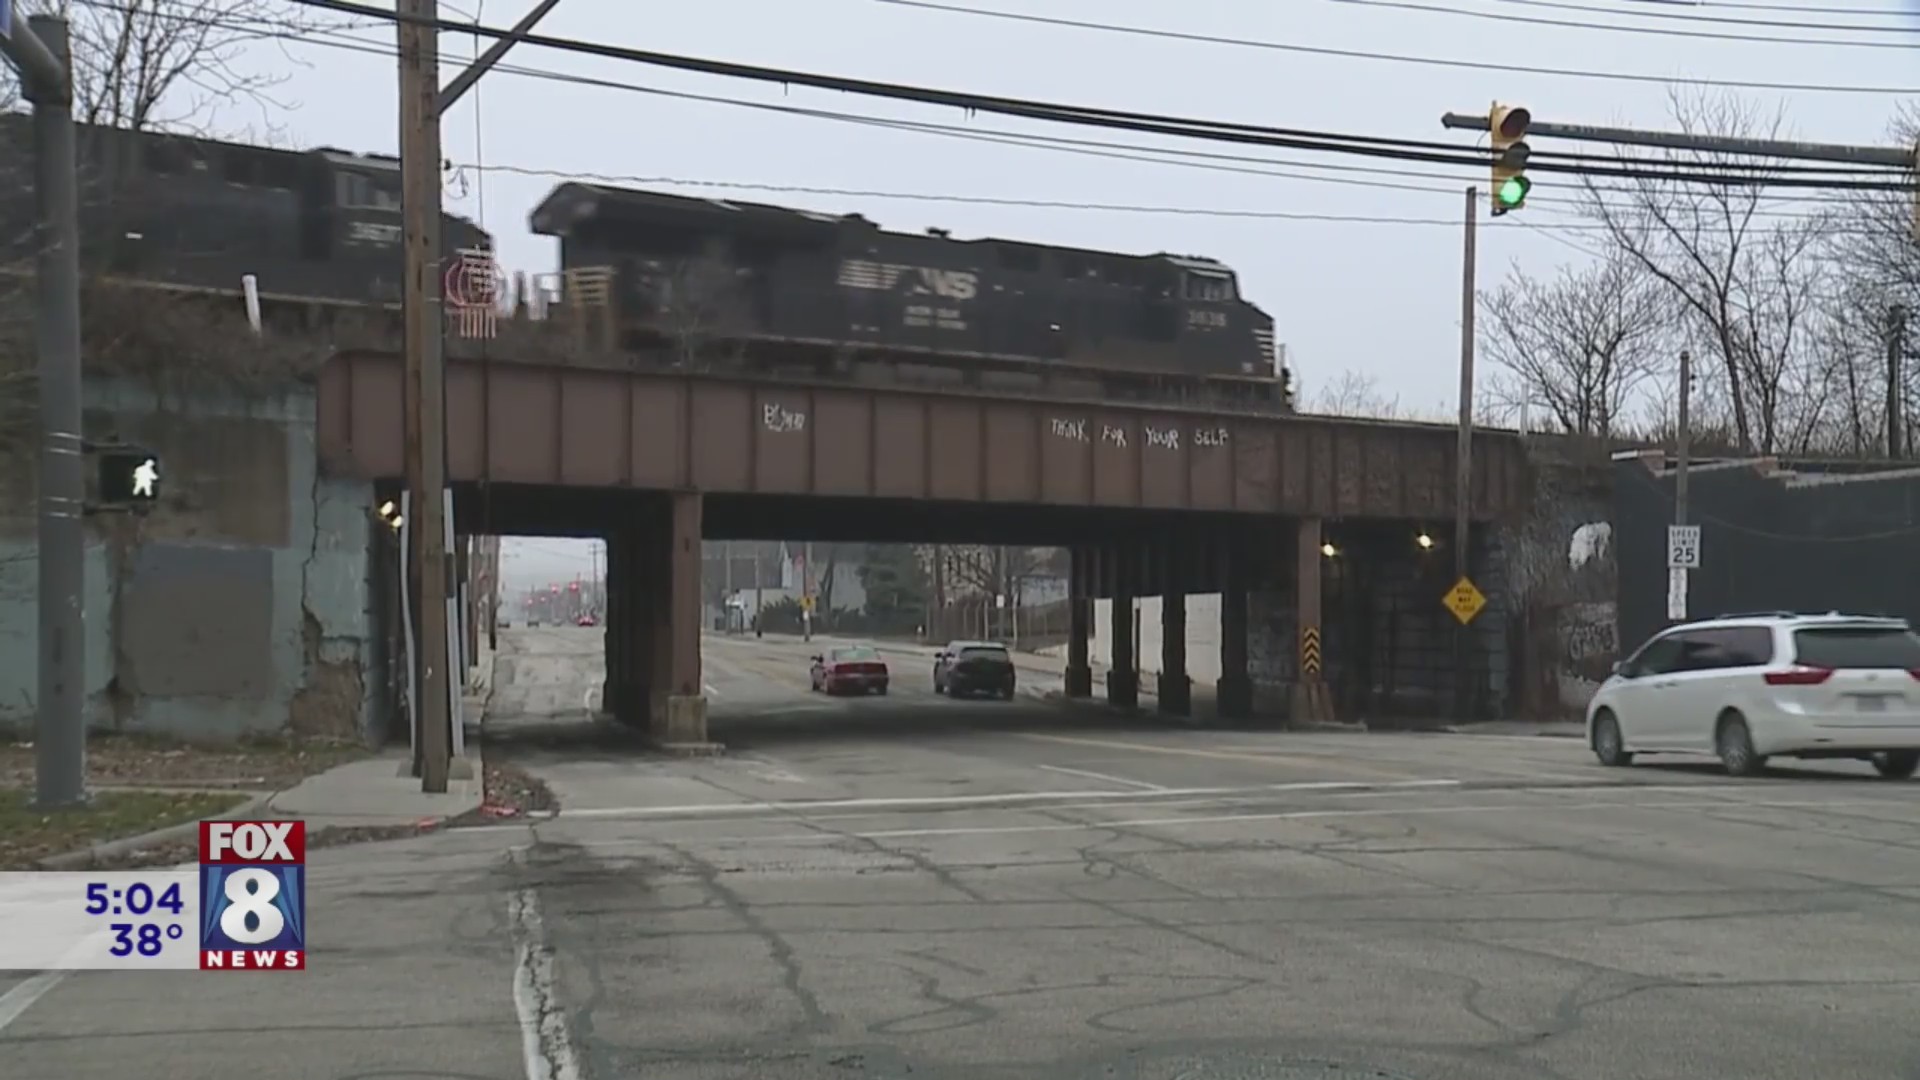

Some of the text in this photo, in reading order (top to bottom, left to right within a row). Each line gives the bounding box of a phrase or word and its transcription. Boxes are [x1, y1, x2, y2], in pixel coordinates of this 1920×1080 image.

[1051, 418, 1229, 449] THINK FOR YOUR SELF
[1673, 547, 1695, 563] 25
